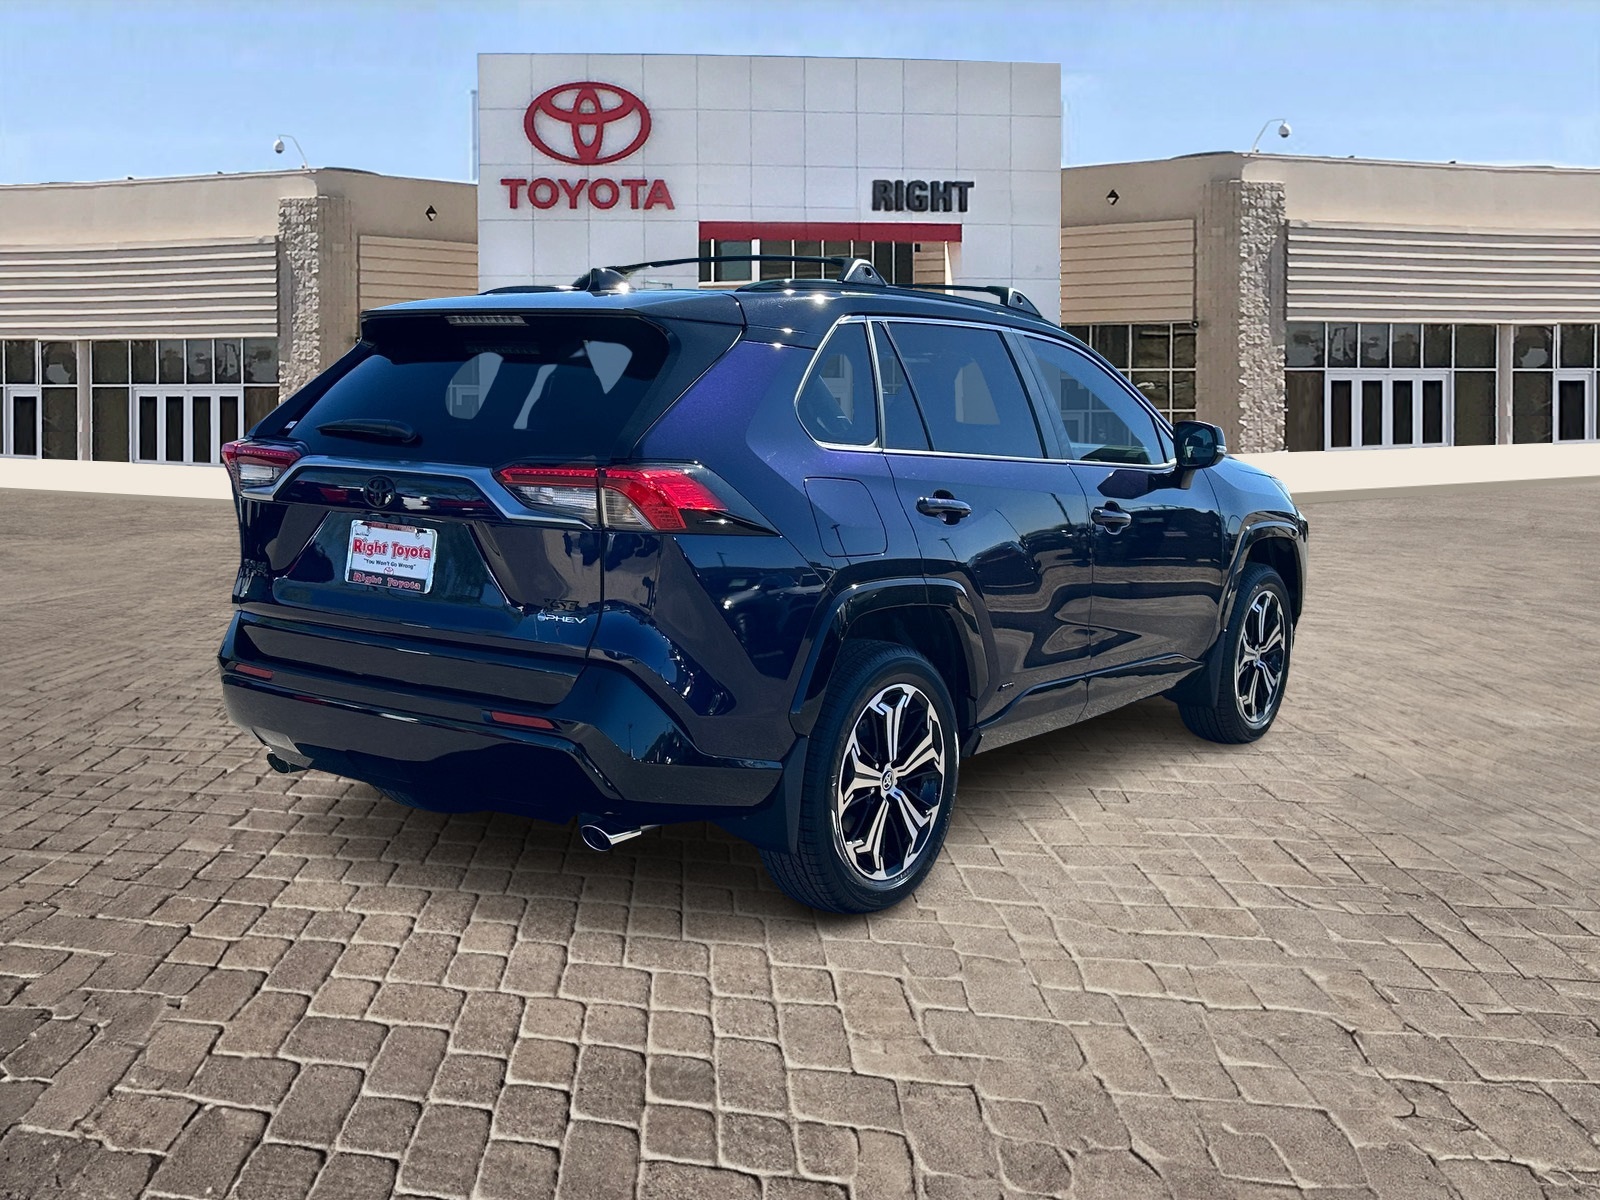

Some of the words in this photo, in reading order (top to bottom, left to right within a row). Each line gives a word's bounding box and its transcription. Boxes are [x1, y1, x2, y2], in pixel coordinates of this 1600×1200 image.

[500, 178, 675, 210] TOYOTA
[872, 179, 975, 212] RIGHT
[353, 537, 388, 557] Right
[391, 541, 432, 560] Toyota
[353, 572, 382, 584] Right
[387, 577, 421, 590] Toyota
[545, 614, 587, 623] PHEV
